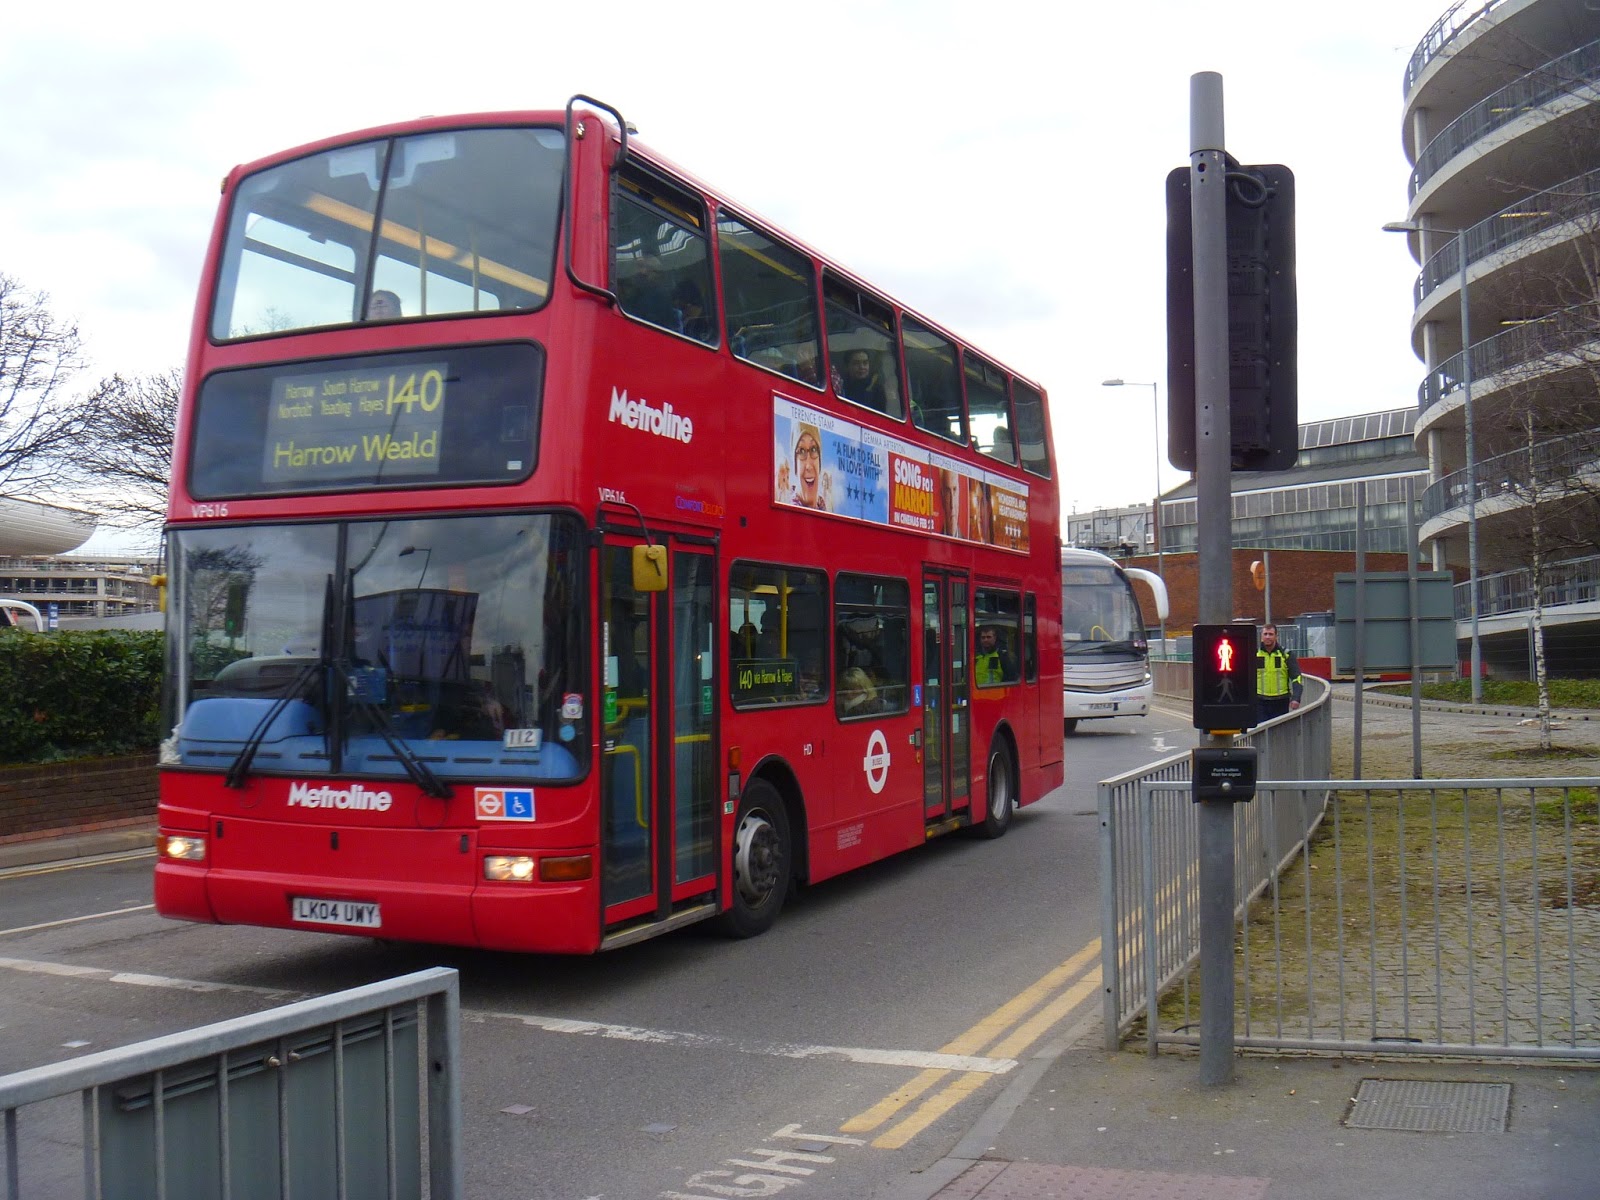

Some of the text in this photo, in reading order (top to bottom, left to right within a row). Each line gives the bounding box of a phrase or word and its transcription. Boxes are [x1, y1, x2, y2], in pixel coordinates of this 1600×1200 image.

[385, 369, 443, 415] 140
[608, 385, 693, 444] Metroline
[791, 406, 835, 431] TERENCE STAMP
[273, 431, 437, 468] Harrow Weald
[863, 432, 882, 448] GEMMA
[838, 457, 846, 472] IN
[846, 459, 862, 476] LOVE
[841, 443, 857, 460] FILM
[857, 448, 866, 462] TO
[867, 450, 881, 468] FALL
[894, 458, 934, 493] SONG FOR
[191, 503, 229, 518] VP616
[894, 483, 934, 517] MARION
[894, 511, 900, 523] IN
[900, 513, 919, 528] CINEMAS
[919, 517, 927, 529] FEB
[739, 669, 753, 689] 140
[509, 730, 534, 745] 112
[803, 743, 813, 756] HD
[287, 781, 393, 812] Metroline
[300, 900, 375, 923] LK04 UWY
